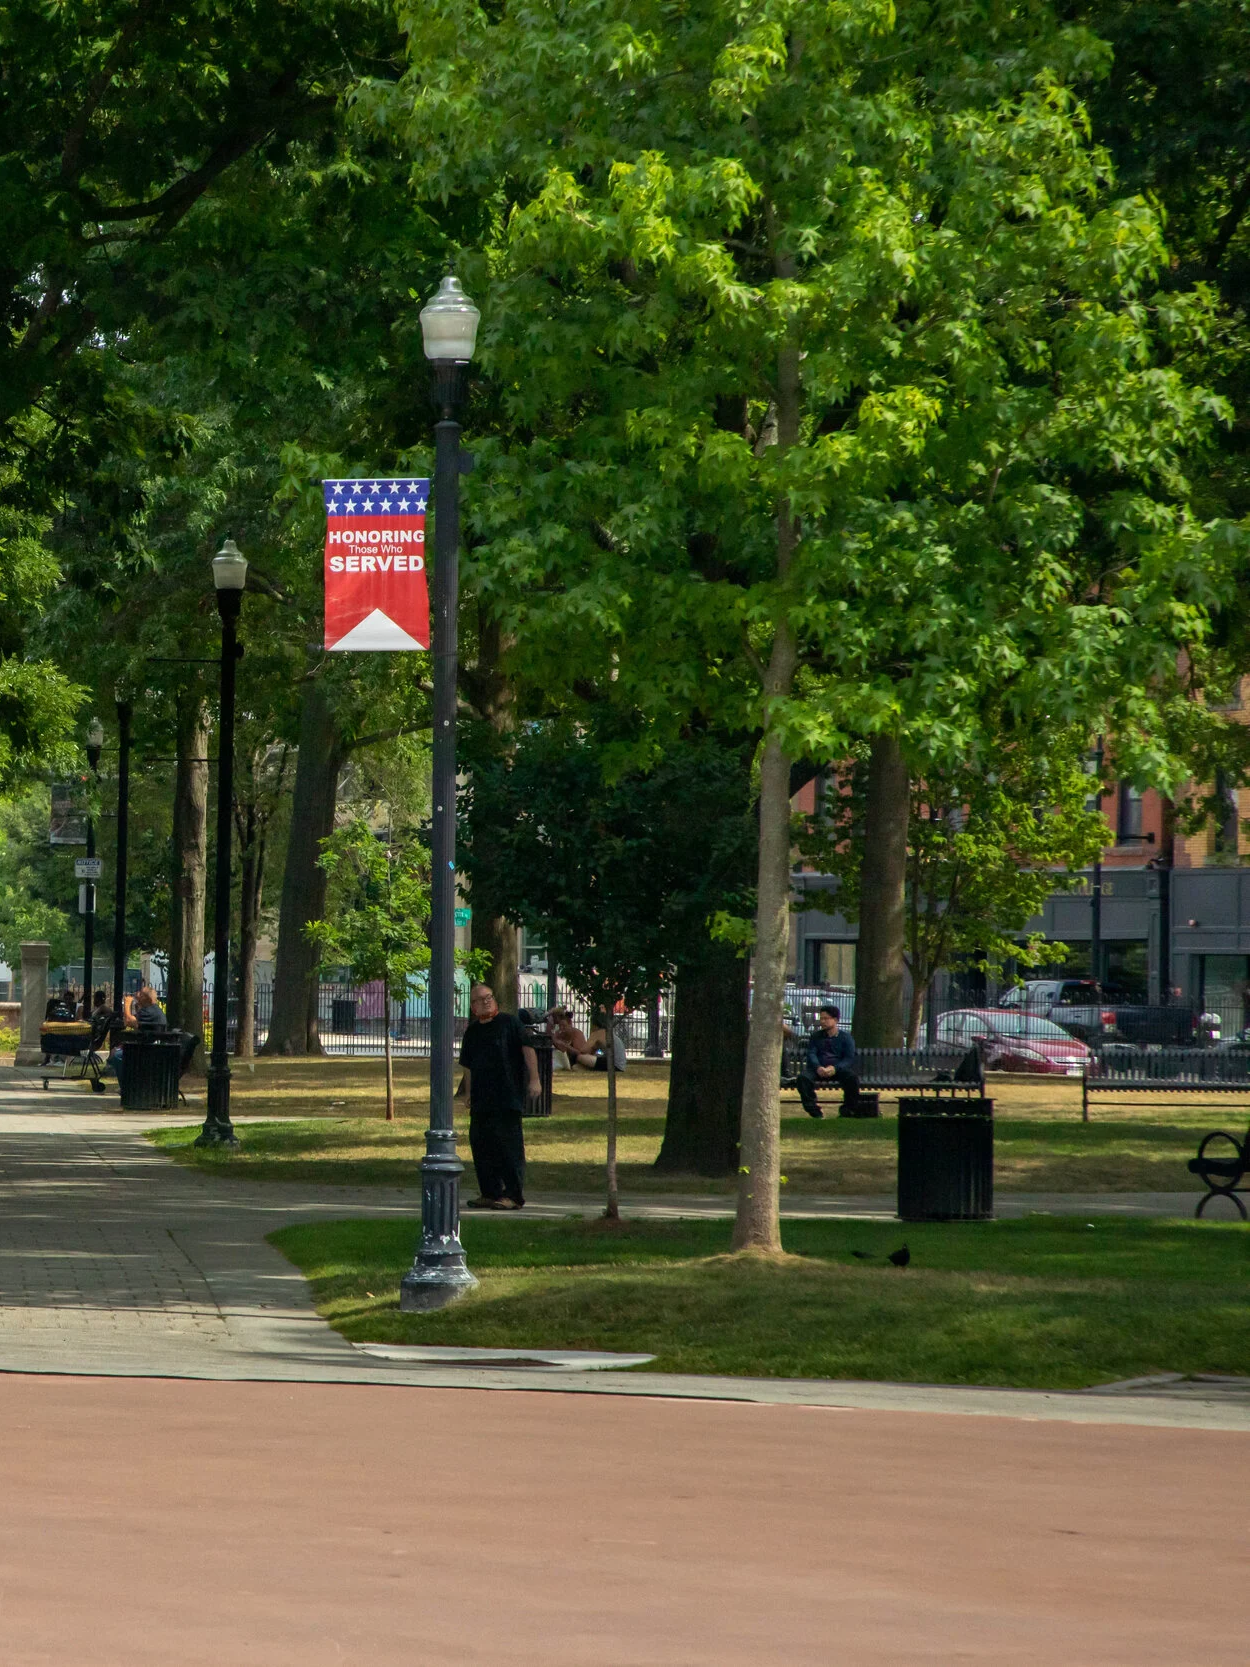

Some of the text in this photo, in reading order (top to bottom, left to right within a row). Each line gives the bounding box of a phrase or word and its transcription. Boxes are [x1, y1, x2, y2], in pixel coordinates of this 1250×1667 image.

[329, 530, 425, 544] HONORING
[349, 545, 403, 554] Those Who
[329, 556, 425, 573] SERVED
